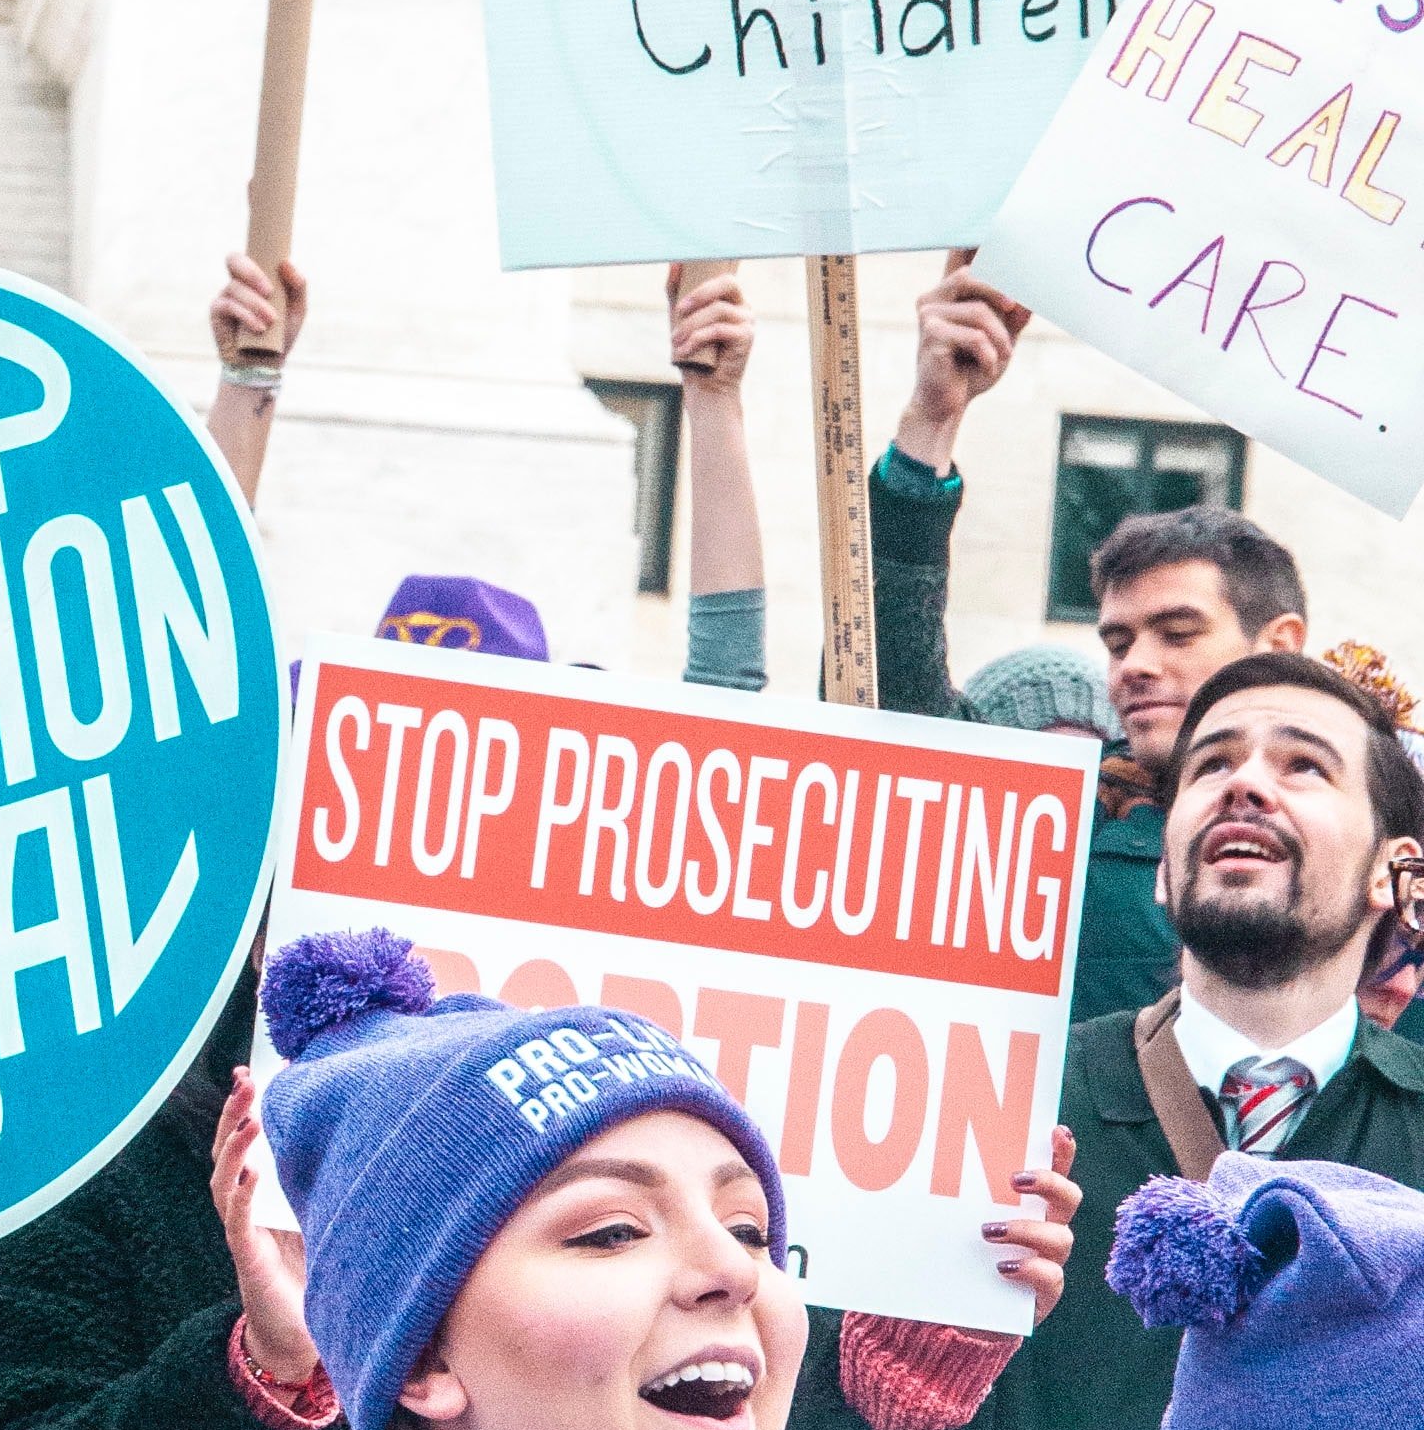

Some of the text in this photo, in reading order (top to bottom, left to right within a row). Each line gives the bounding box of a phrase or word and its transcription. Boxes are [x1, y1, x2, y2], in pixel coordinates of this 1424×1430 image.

[1086, 197, 1398, 433] CARE.
[312, 695, 1067, 962] STOP PROSECUTING
